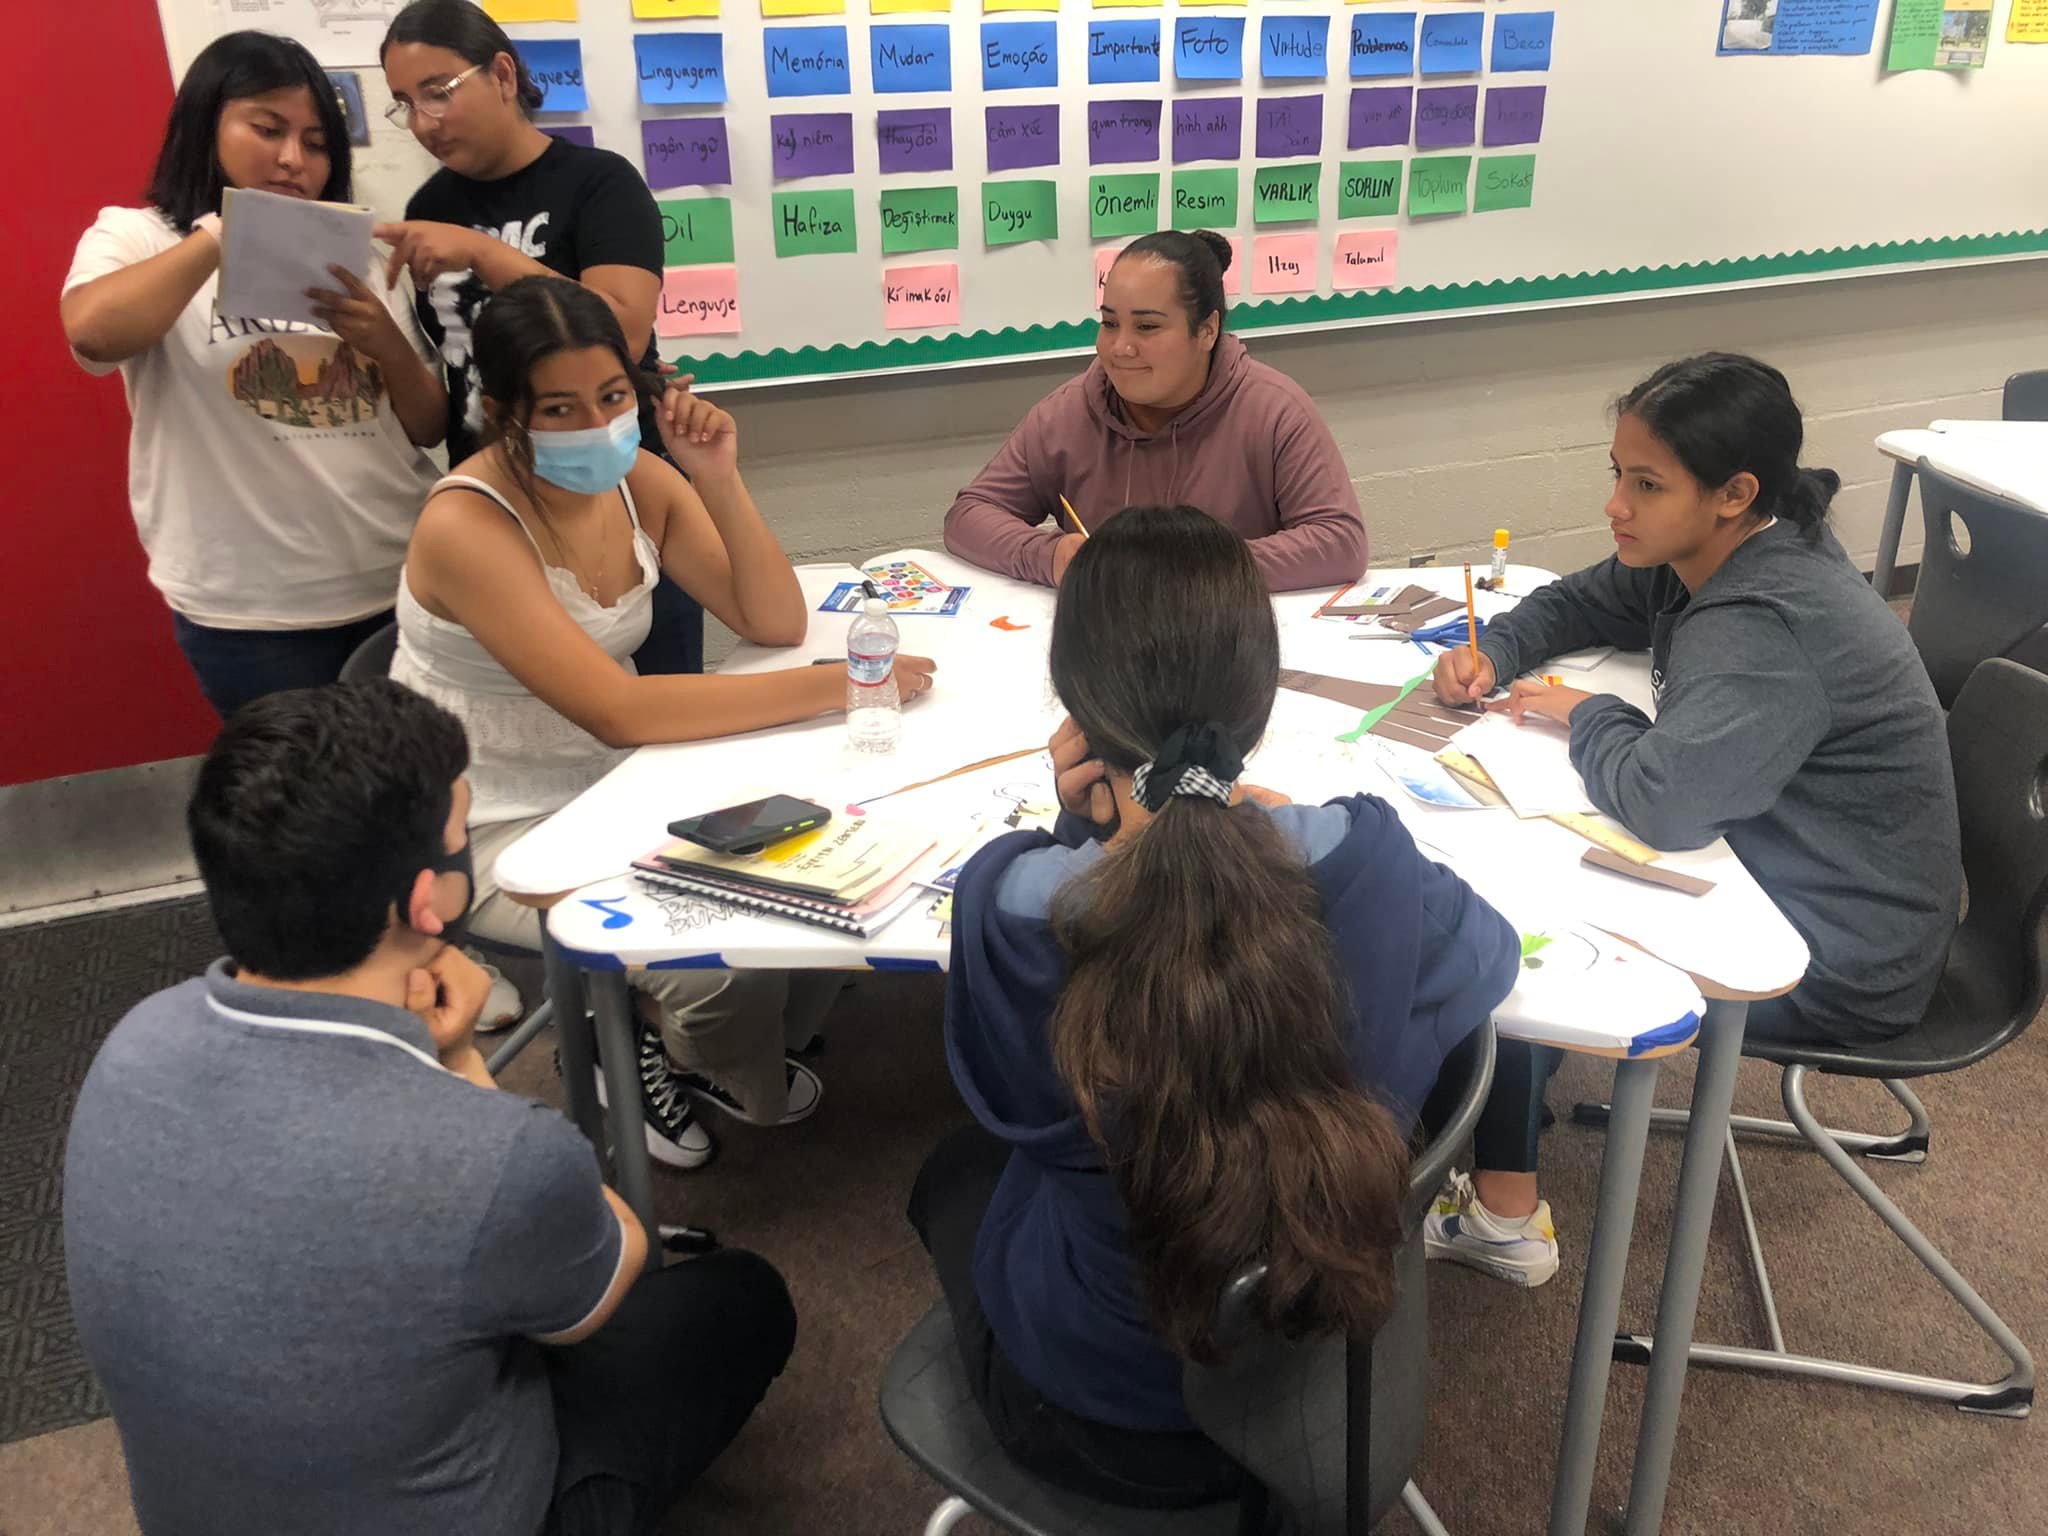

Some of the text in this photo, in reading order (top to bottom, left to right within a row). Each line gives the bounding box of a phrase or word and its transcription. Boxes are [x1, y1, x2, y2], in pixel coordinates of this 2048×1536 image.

[1091, 32, 1160, 62] Importante
[1181, 28, 1229, 58] Foto
[1269, 30, 1322, 58] Virtude
[1352, 28, 1409, 56] Problemas
[1504, 29, 1545, 50] Beco
[772, 46, 845, 75] Memória
[879, 43, 935, 69] Mudar
[530, 68, 583, 97] uguese
[1095, 184, 1155, 216] Önemli
[1259, 182, 1313, 203] VARLIK
[1345, 177, 1394, 198] SORUN
[1413, 170, 1463, 204] Toplum
[661, 213, 693, 242] Dil
[989, 201, 1032, 231] Duygu
